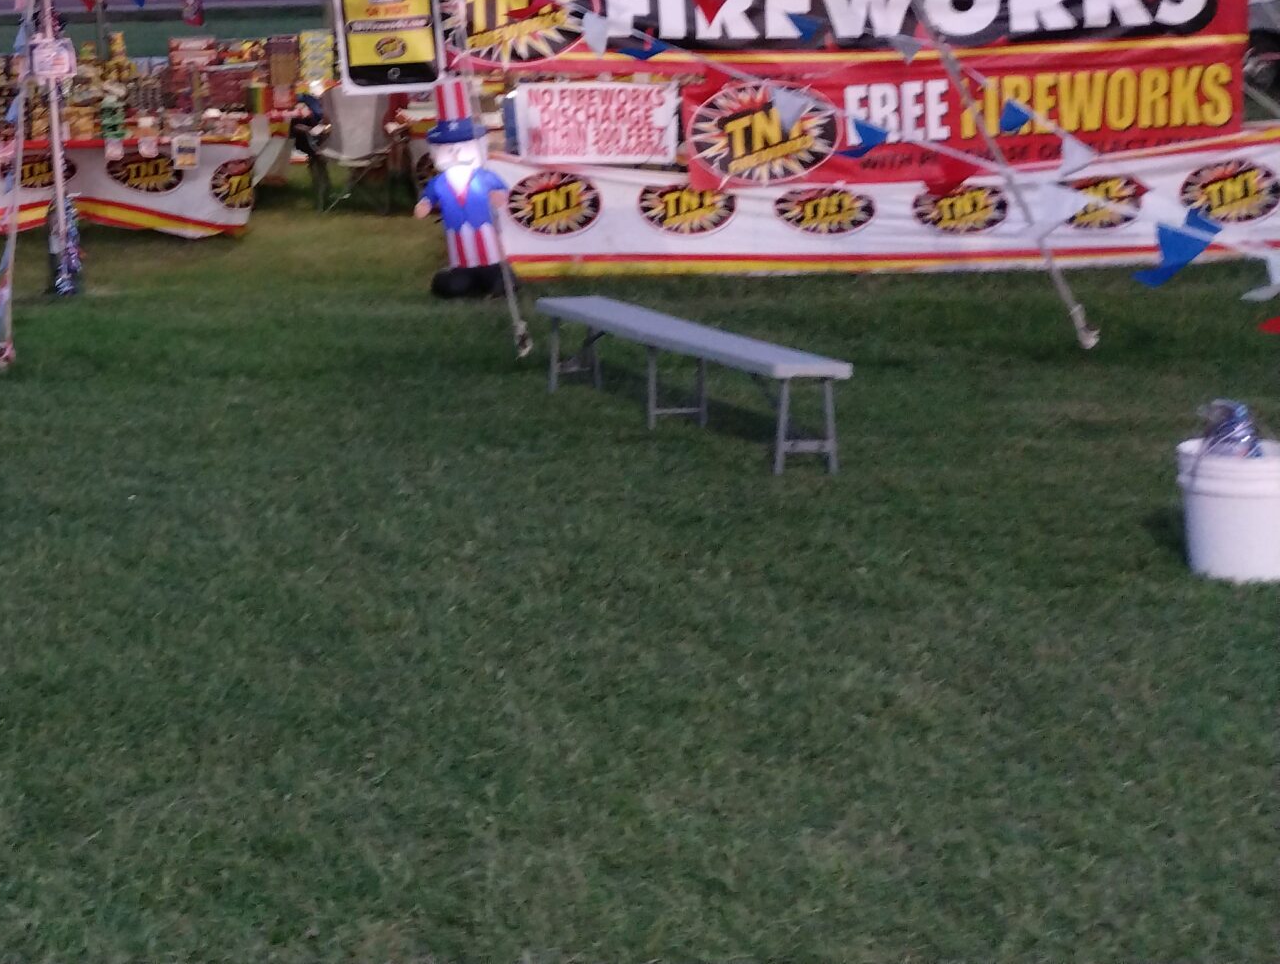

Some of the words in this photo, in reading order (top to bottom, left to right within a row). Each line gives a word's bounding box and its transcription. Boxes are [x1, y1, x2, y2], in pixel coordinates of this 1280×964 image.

[527, 89, 554, 106] NO
[559, 88, 666, 107] FIREWORKS
[844, 79, 951, 146] FREE
[540, 105, 654, 127] DISCHARGE
[531, 183, 584, 220] TNT
[1203, 170, 1262, 206] TNT
